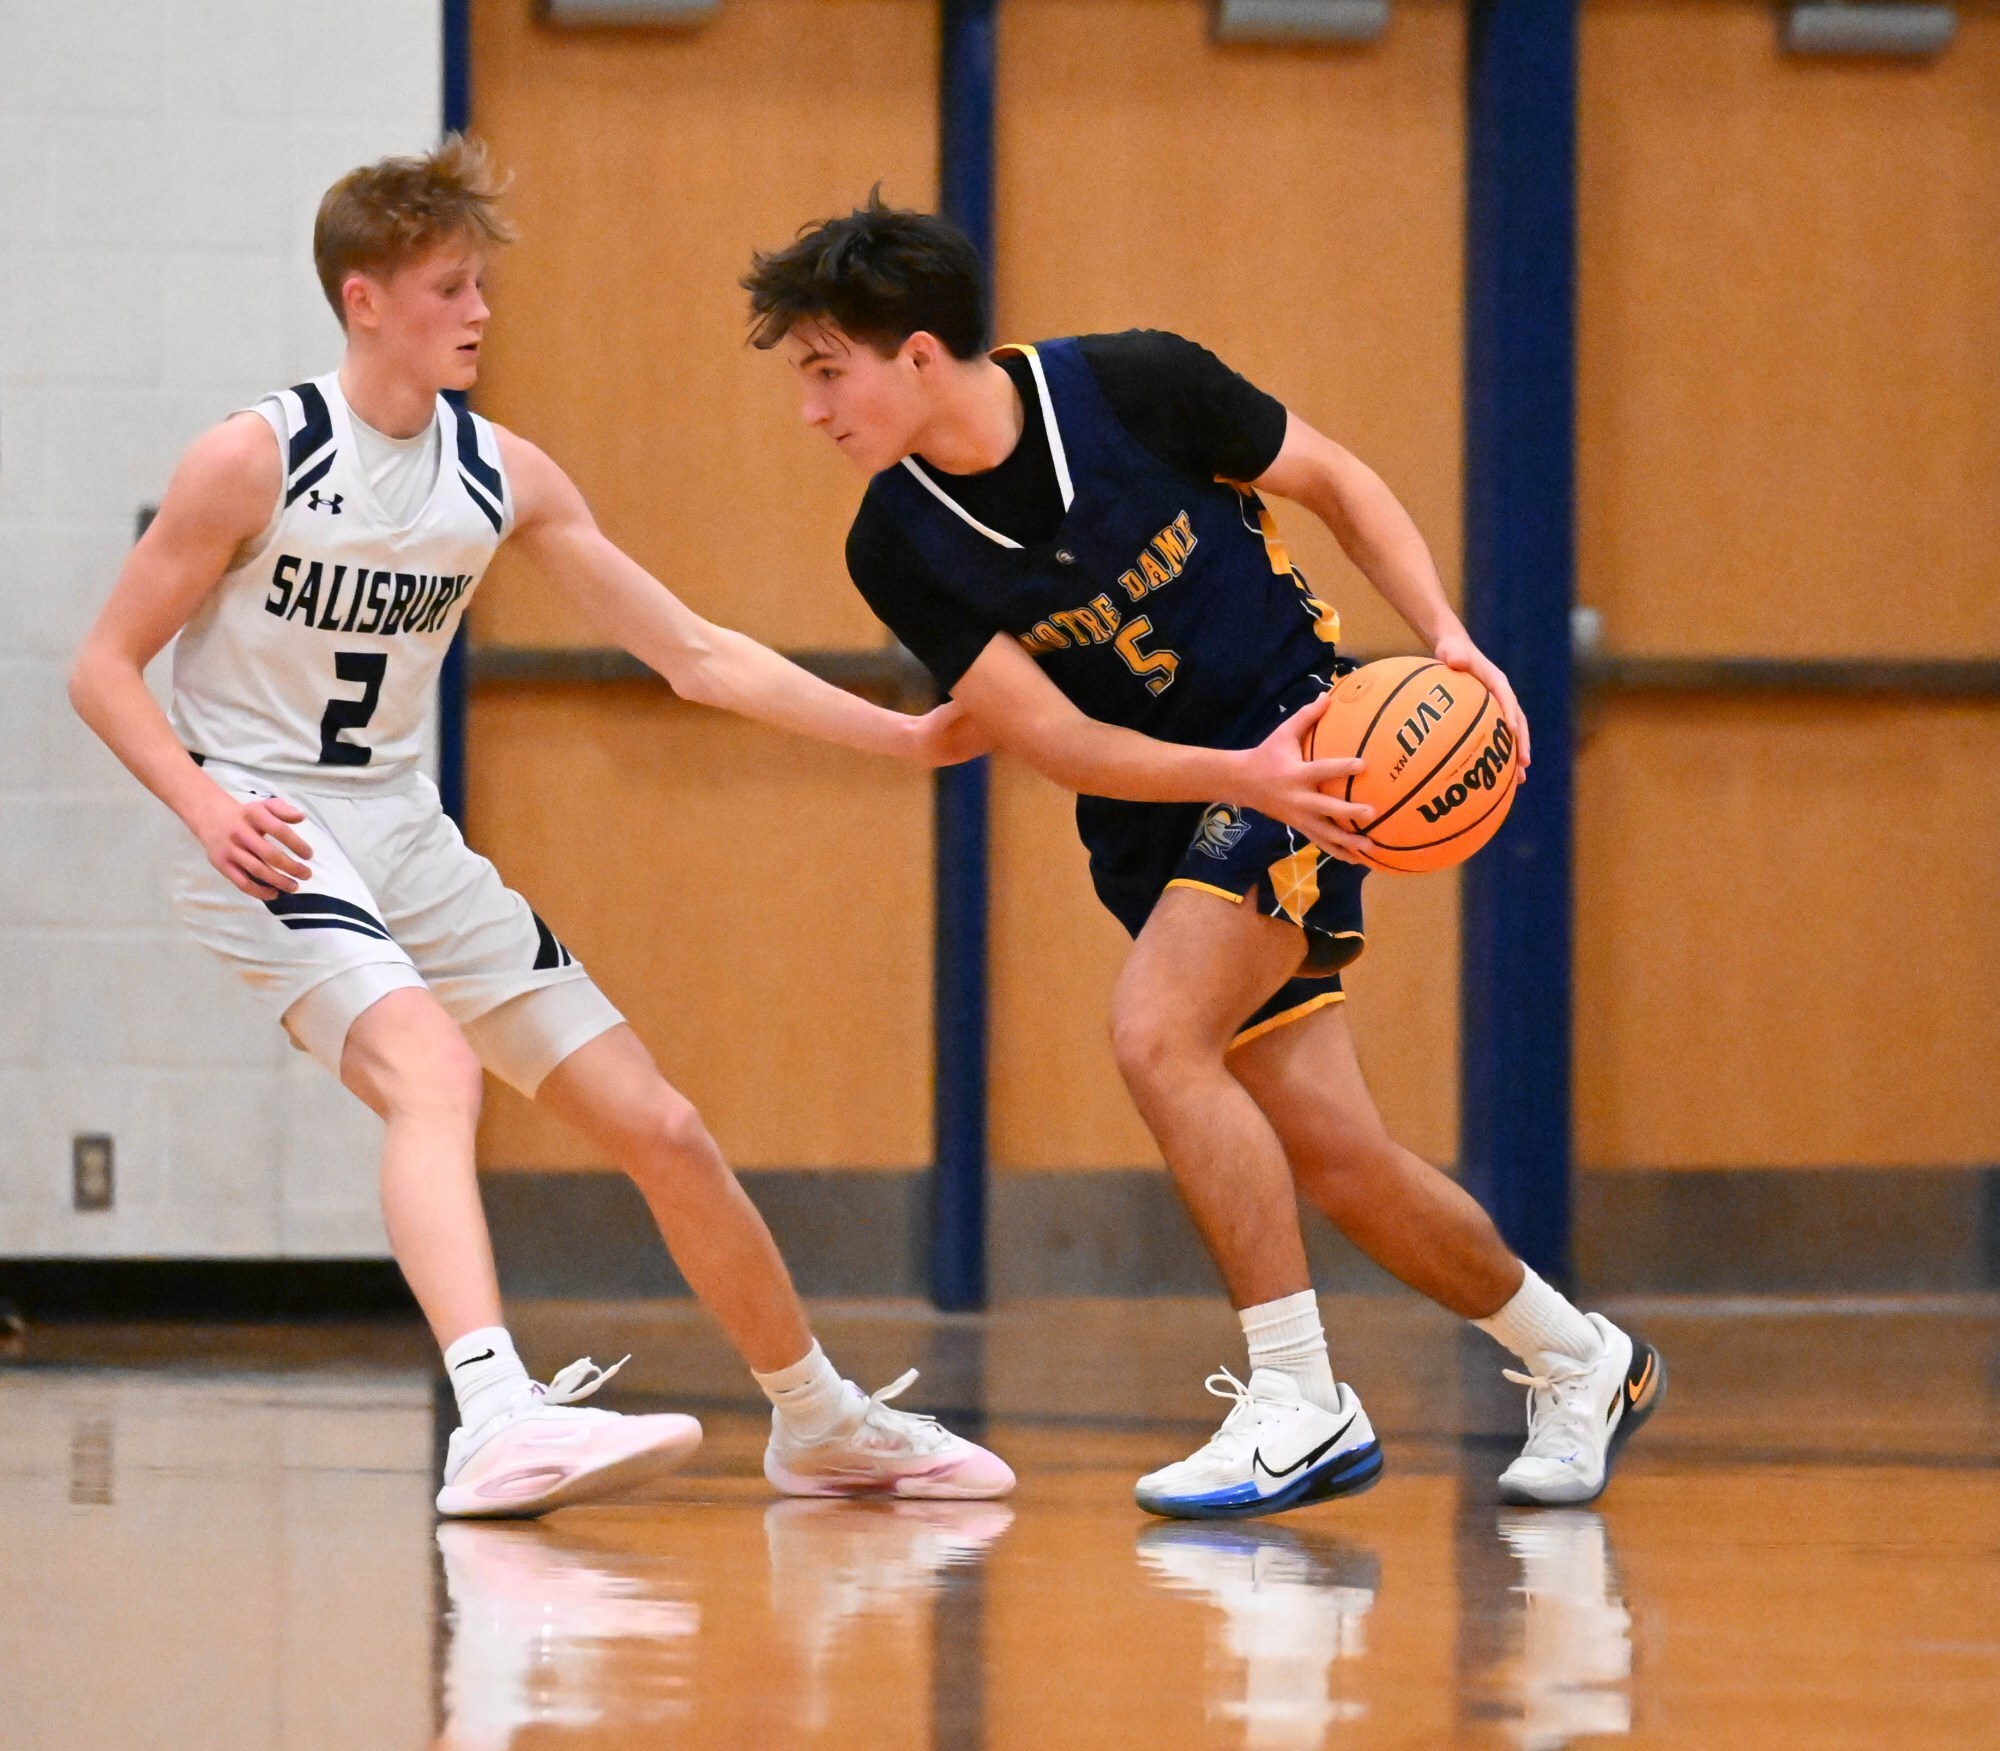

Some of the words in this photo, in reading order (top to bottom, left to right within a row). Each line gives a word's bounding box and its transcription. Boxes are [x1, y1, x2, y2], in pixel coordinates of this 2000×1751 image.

[265, 554, 473, 636] SALISBURY
[1113, 615, 1182, 697] 5
[319, 652, 388, 766] 2
[1389, 754, 1408, 783] NXT
[1416, 717, 1513, 824] Wilson
